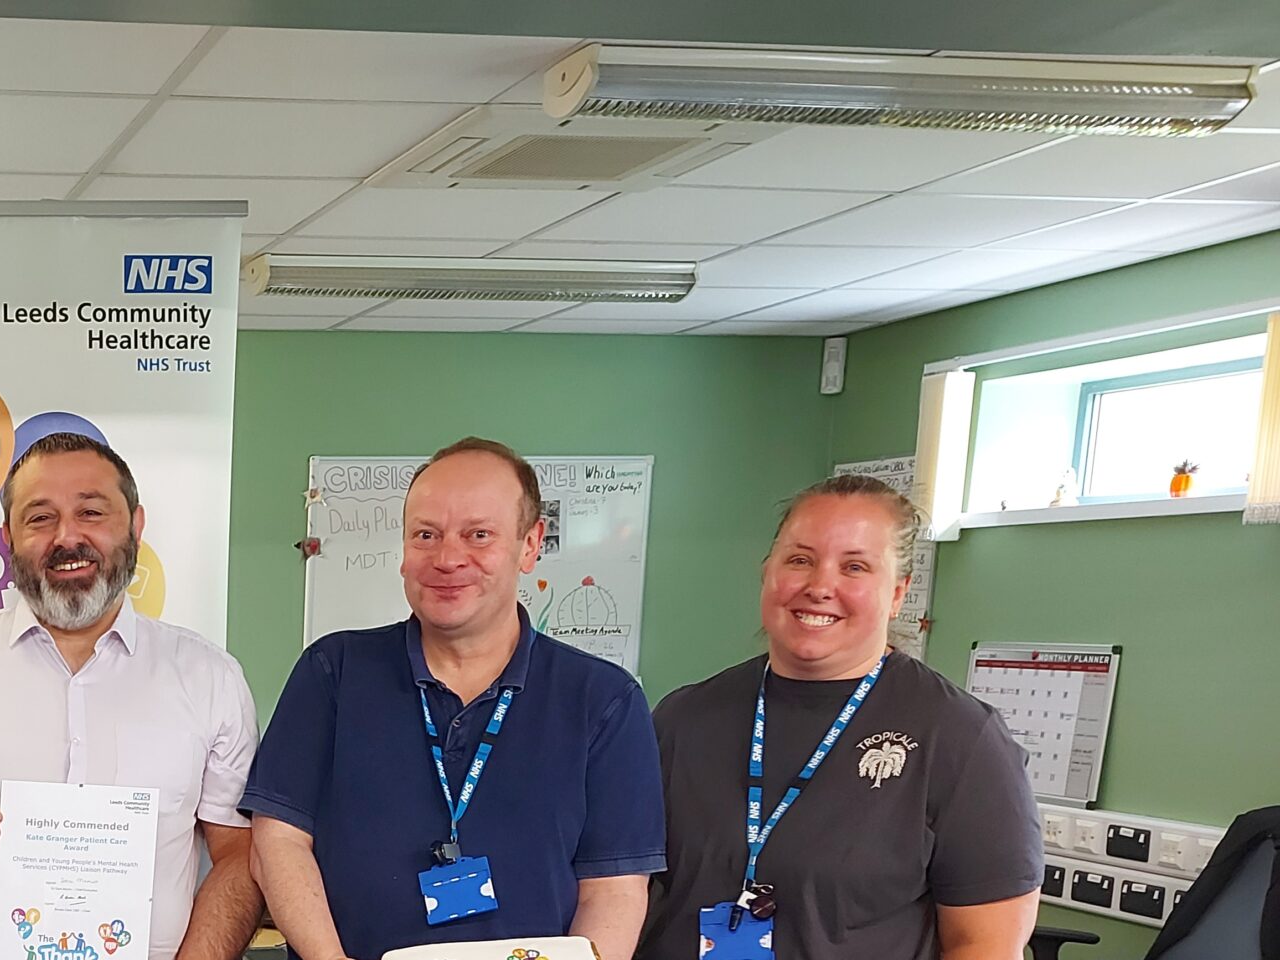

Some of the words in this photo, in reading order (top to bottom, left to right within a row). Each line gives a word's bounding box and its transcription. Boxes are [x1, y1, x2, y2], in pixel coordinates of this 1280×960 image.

[126, 258, 210, 291] NHS
[3, 302, 69, 323] Leeds
[77, 303, 211, 328] Community
[88, 329, 211, 350] Healthcare
[137, 358, 169, 371] NHS
[174, 358, 211, 372] Trust
[324, 465, 416, 493] CRISIS
[536, 464, 577, 487] NE!
[585, 465, 615, 480] Which
[329, 509, 370, 540] Daily
[374, 506, 403, 532] Pla
[550, 628, 569, 636] Team
[572, 627, 598, 636] Meeting
[1073, 655, 1110, 664] PLANNER
[854, 681, 871, 701] NHS
[494, 703, 508, 722] NHS
[838, 704, 856, 724] NHS
[823, 727, 840, 747] NHS
[856, 731, 919, 751] TROPICALE
[752, 742, 763, 762] NHS
[807, 750, 825, 769] NHS
[470, 758, 484, 779] NHS
[460, 782, 474, 803] NHS
[749, 801, 761, 819] NHS
[26, 818, 60, 829] Highly
[63, 820, 129, 831] Commended
[748, 825, 760, 843] NHS
[46, 835, 77, 844] Granger
[80, 836, 107, 844] Patient
[38, 934, 55, 943] The
